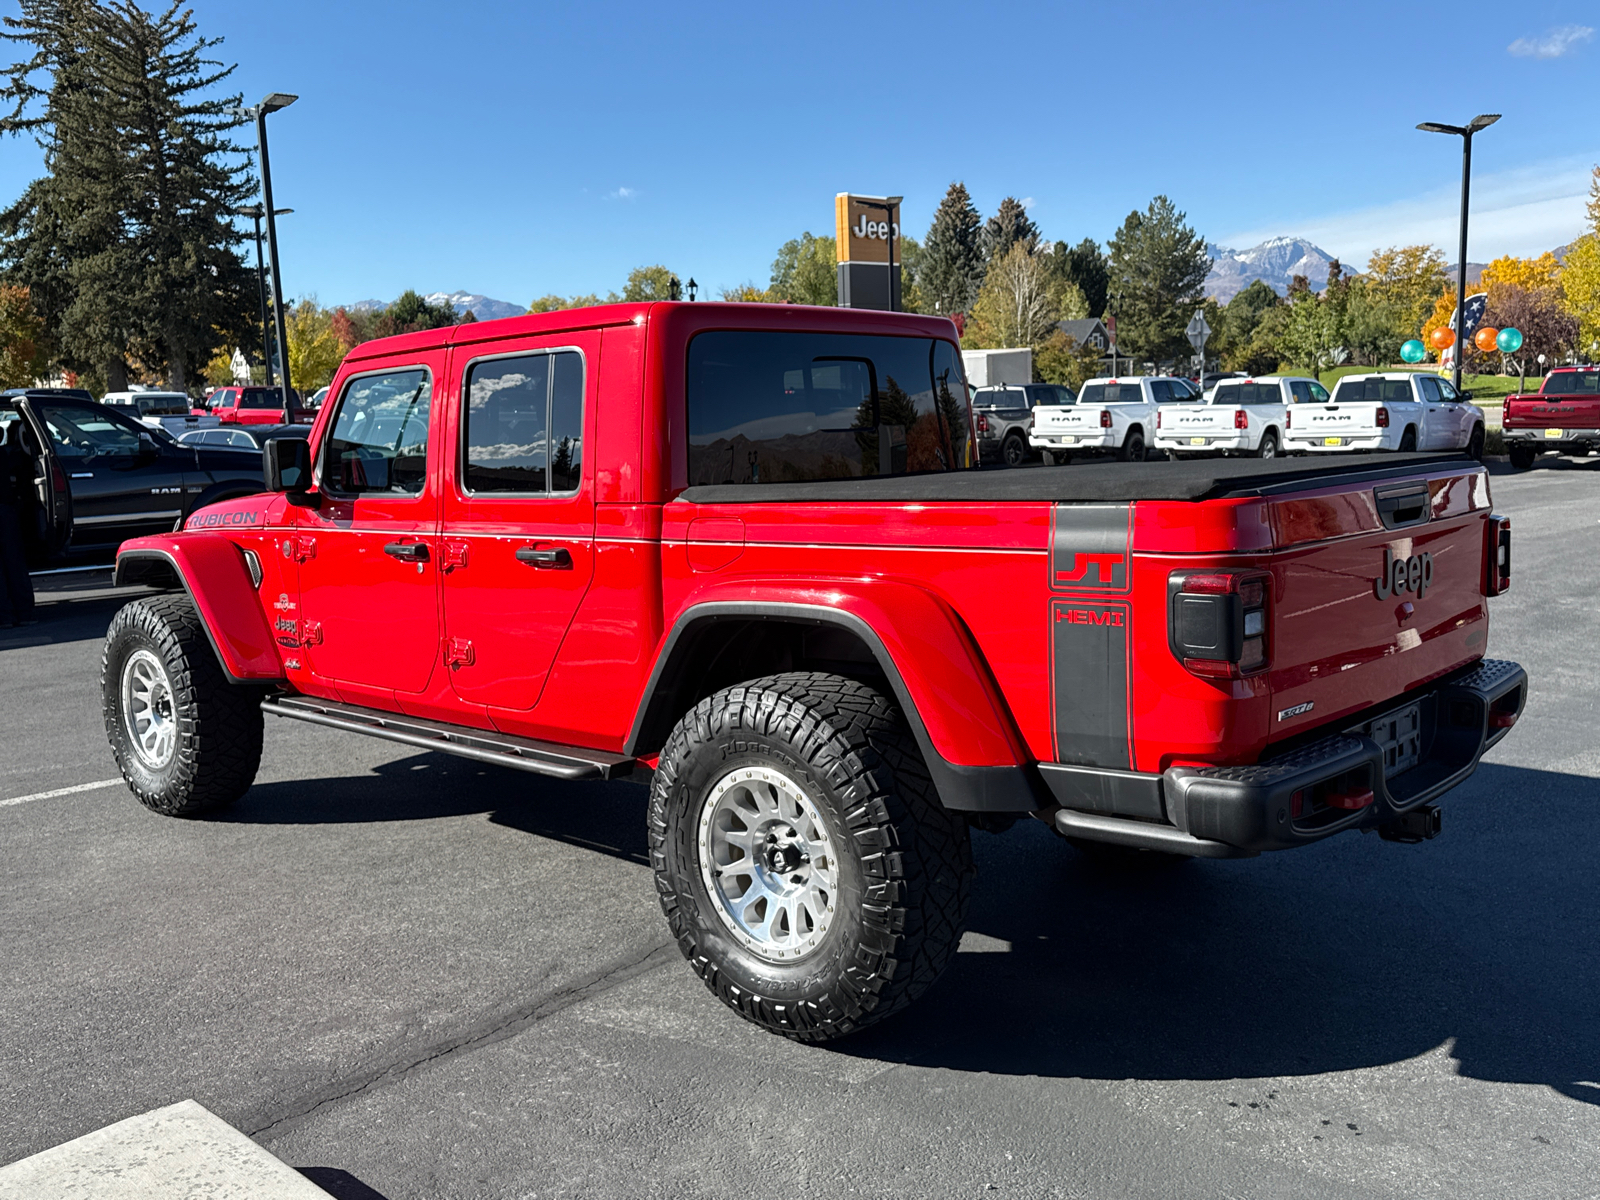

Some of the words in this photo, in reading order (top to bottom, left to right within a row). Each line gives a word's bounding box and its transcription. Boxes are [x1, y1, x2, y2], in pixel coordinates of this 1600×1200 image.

[189, 511, 258, 527] RUBICON
[1055, 552, 1125, 583] JT
[1373, 548, 1434, 601] Jeep
[274, 614, 298, 635] Jeep
[1055, 608, 1124, 627] HEMI
[718, 738, 771, 760] RIDGE
